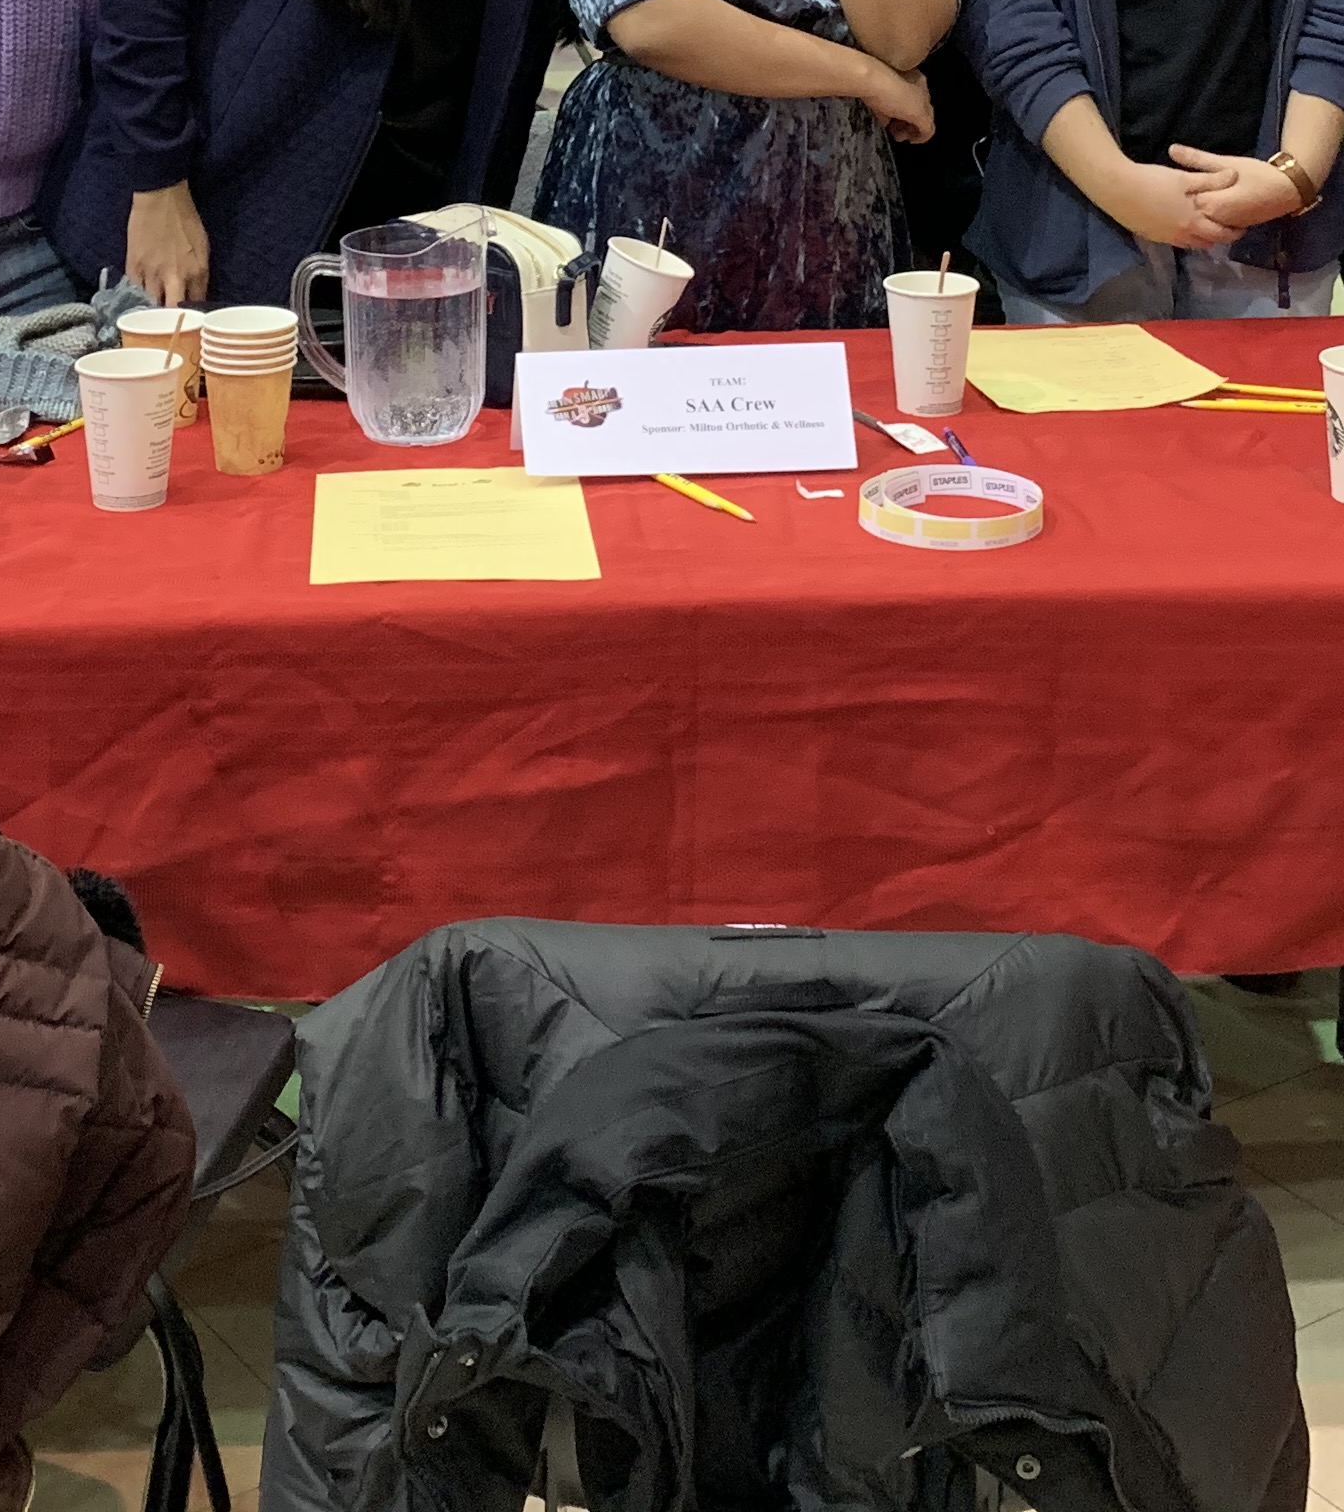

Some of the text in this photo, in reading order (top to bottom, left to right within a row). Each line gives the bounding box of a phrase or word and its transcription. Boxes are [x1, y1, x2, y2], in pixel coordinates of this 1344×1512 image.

[709, 376, 747, 387] TEAM:
[685, 396, 777, 414] SAA Crew
[641, 419, 826, 437] Sponsor: Milton Orthotic & Wellness
[932, 475, 969, 487] STAPLES
[985, 481, 1017, 494] STAPLES
